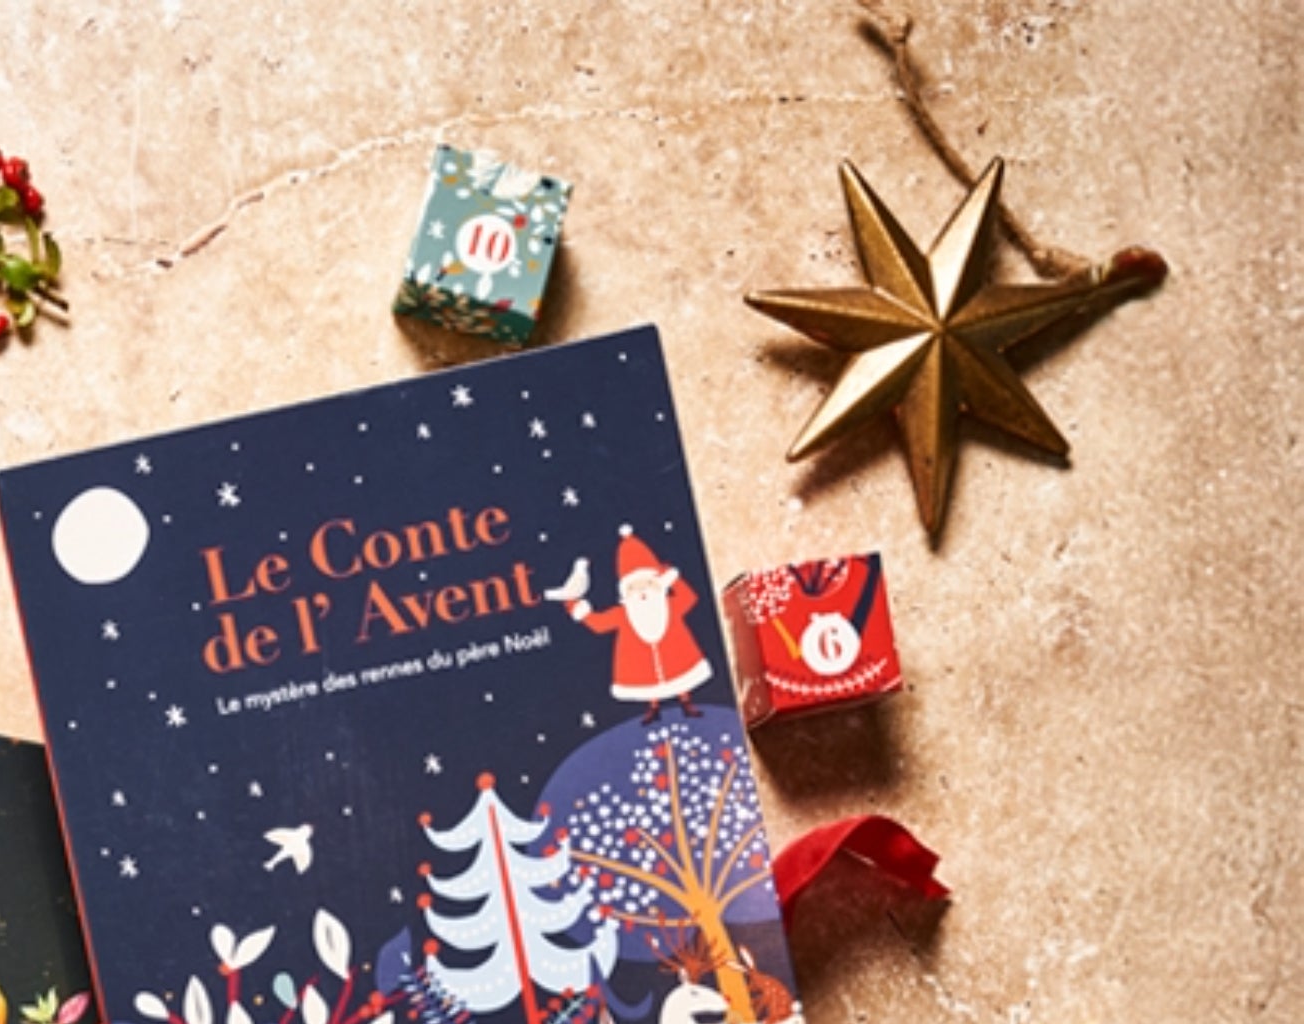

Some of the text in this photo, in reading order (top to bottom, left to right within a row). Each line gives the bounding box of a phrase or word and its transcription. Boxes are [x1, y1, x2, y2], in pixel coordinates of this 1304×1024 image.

[468, 223, 511, 263] 10
[200, 505, 511, 606] Le Conte
[201, 612, 282, 675] de
[354, 561, 543, 644] Avent
[817, 626, 843, 661] 6
[215, 625, 552, 716] Le mystère des rennes du père Noël
